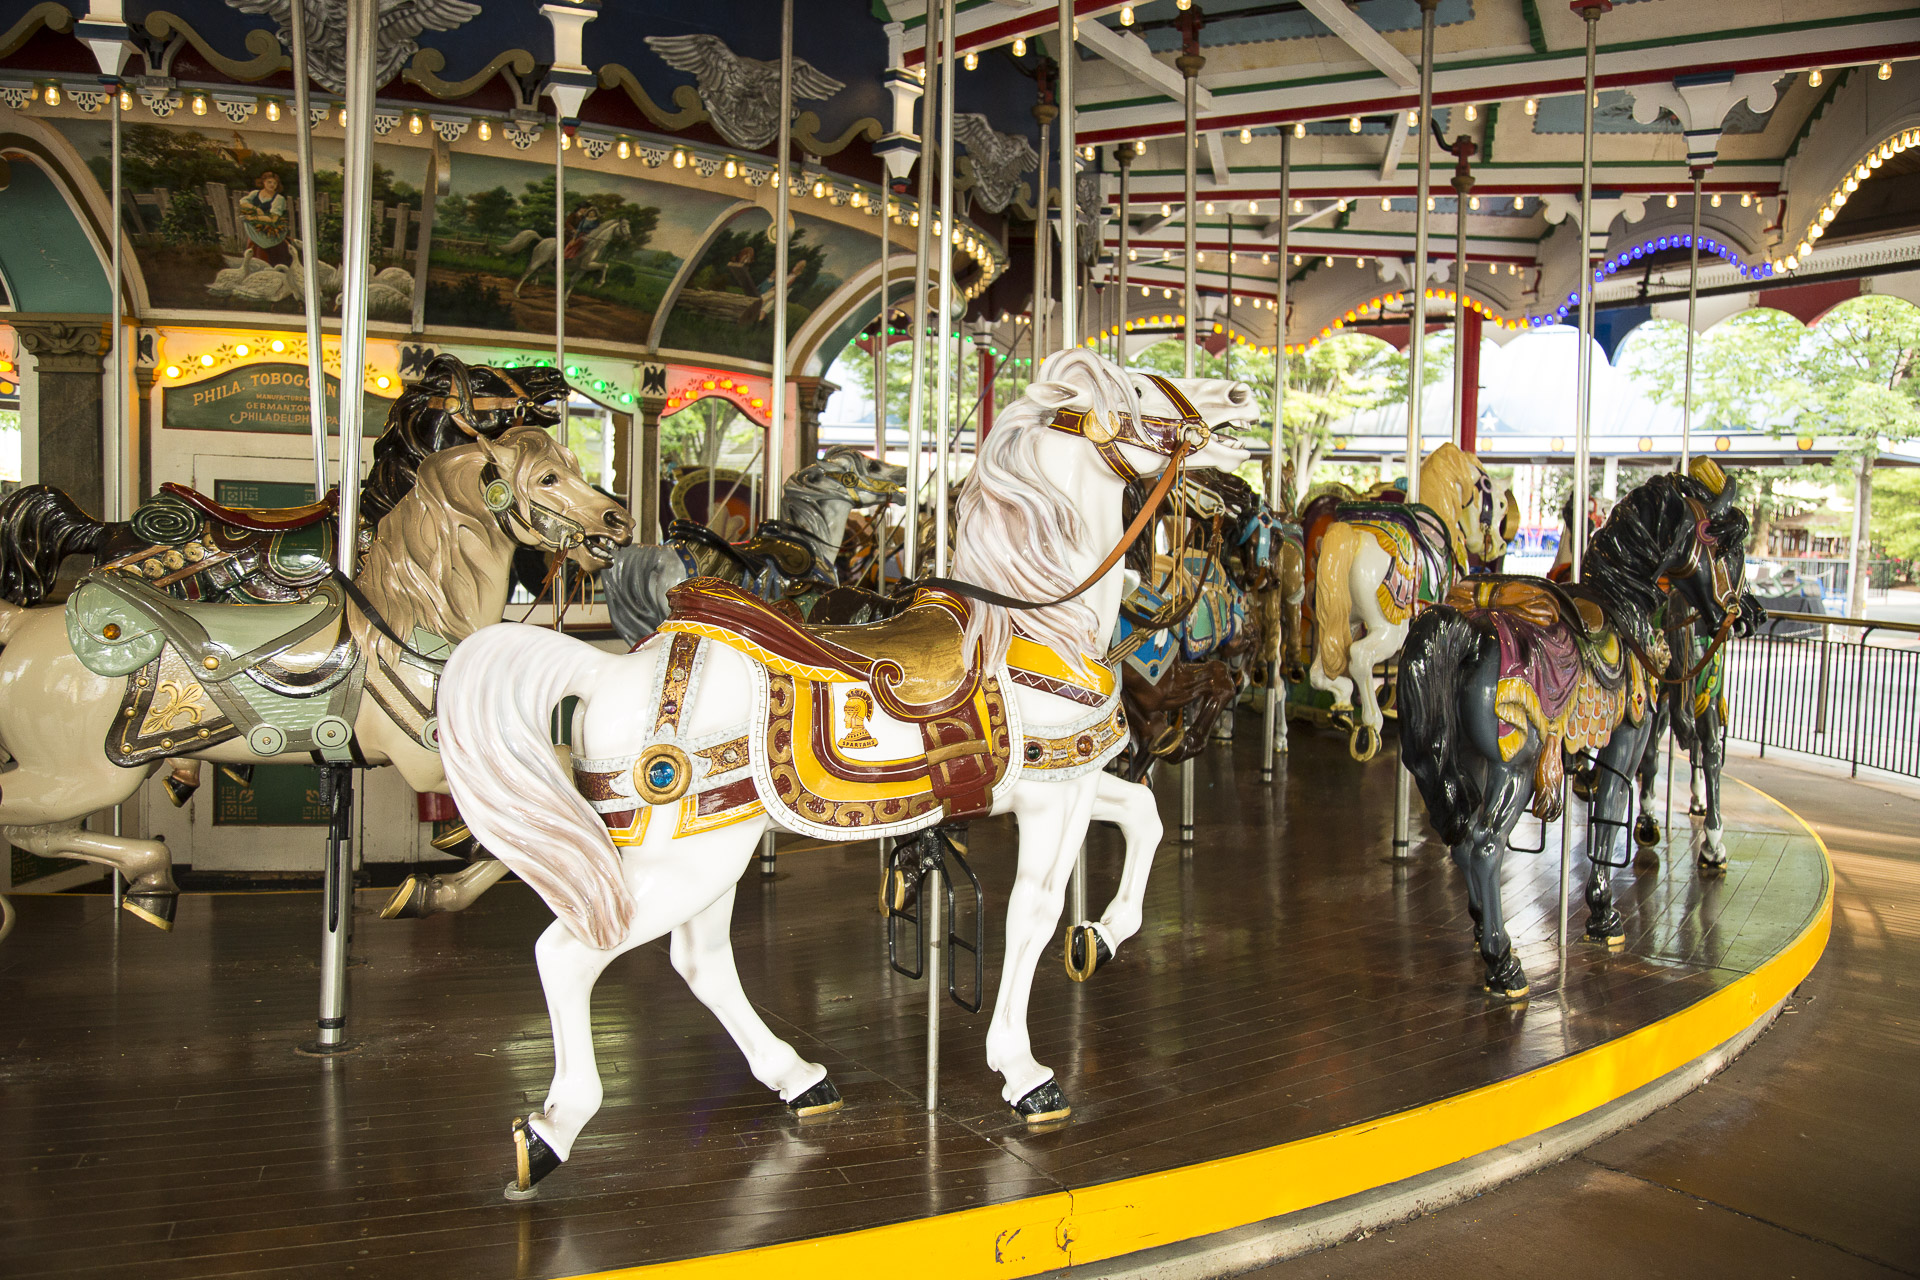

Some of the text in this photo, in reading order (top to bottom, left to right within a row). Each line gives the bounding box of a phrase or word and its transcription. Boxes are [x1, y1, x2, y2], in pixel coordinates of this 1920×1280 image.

[193, 372, 336, 406] PHILA. TOBOGN
[246, 402, 312, 412] GERMANTOW
[230, 411, 312, 425] PHILADELPH
[842, 740, 875, 748] SPARTANS
